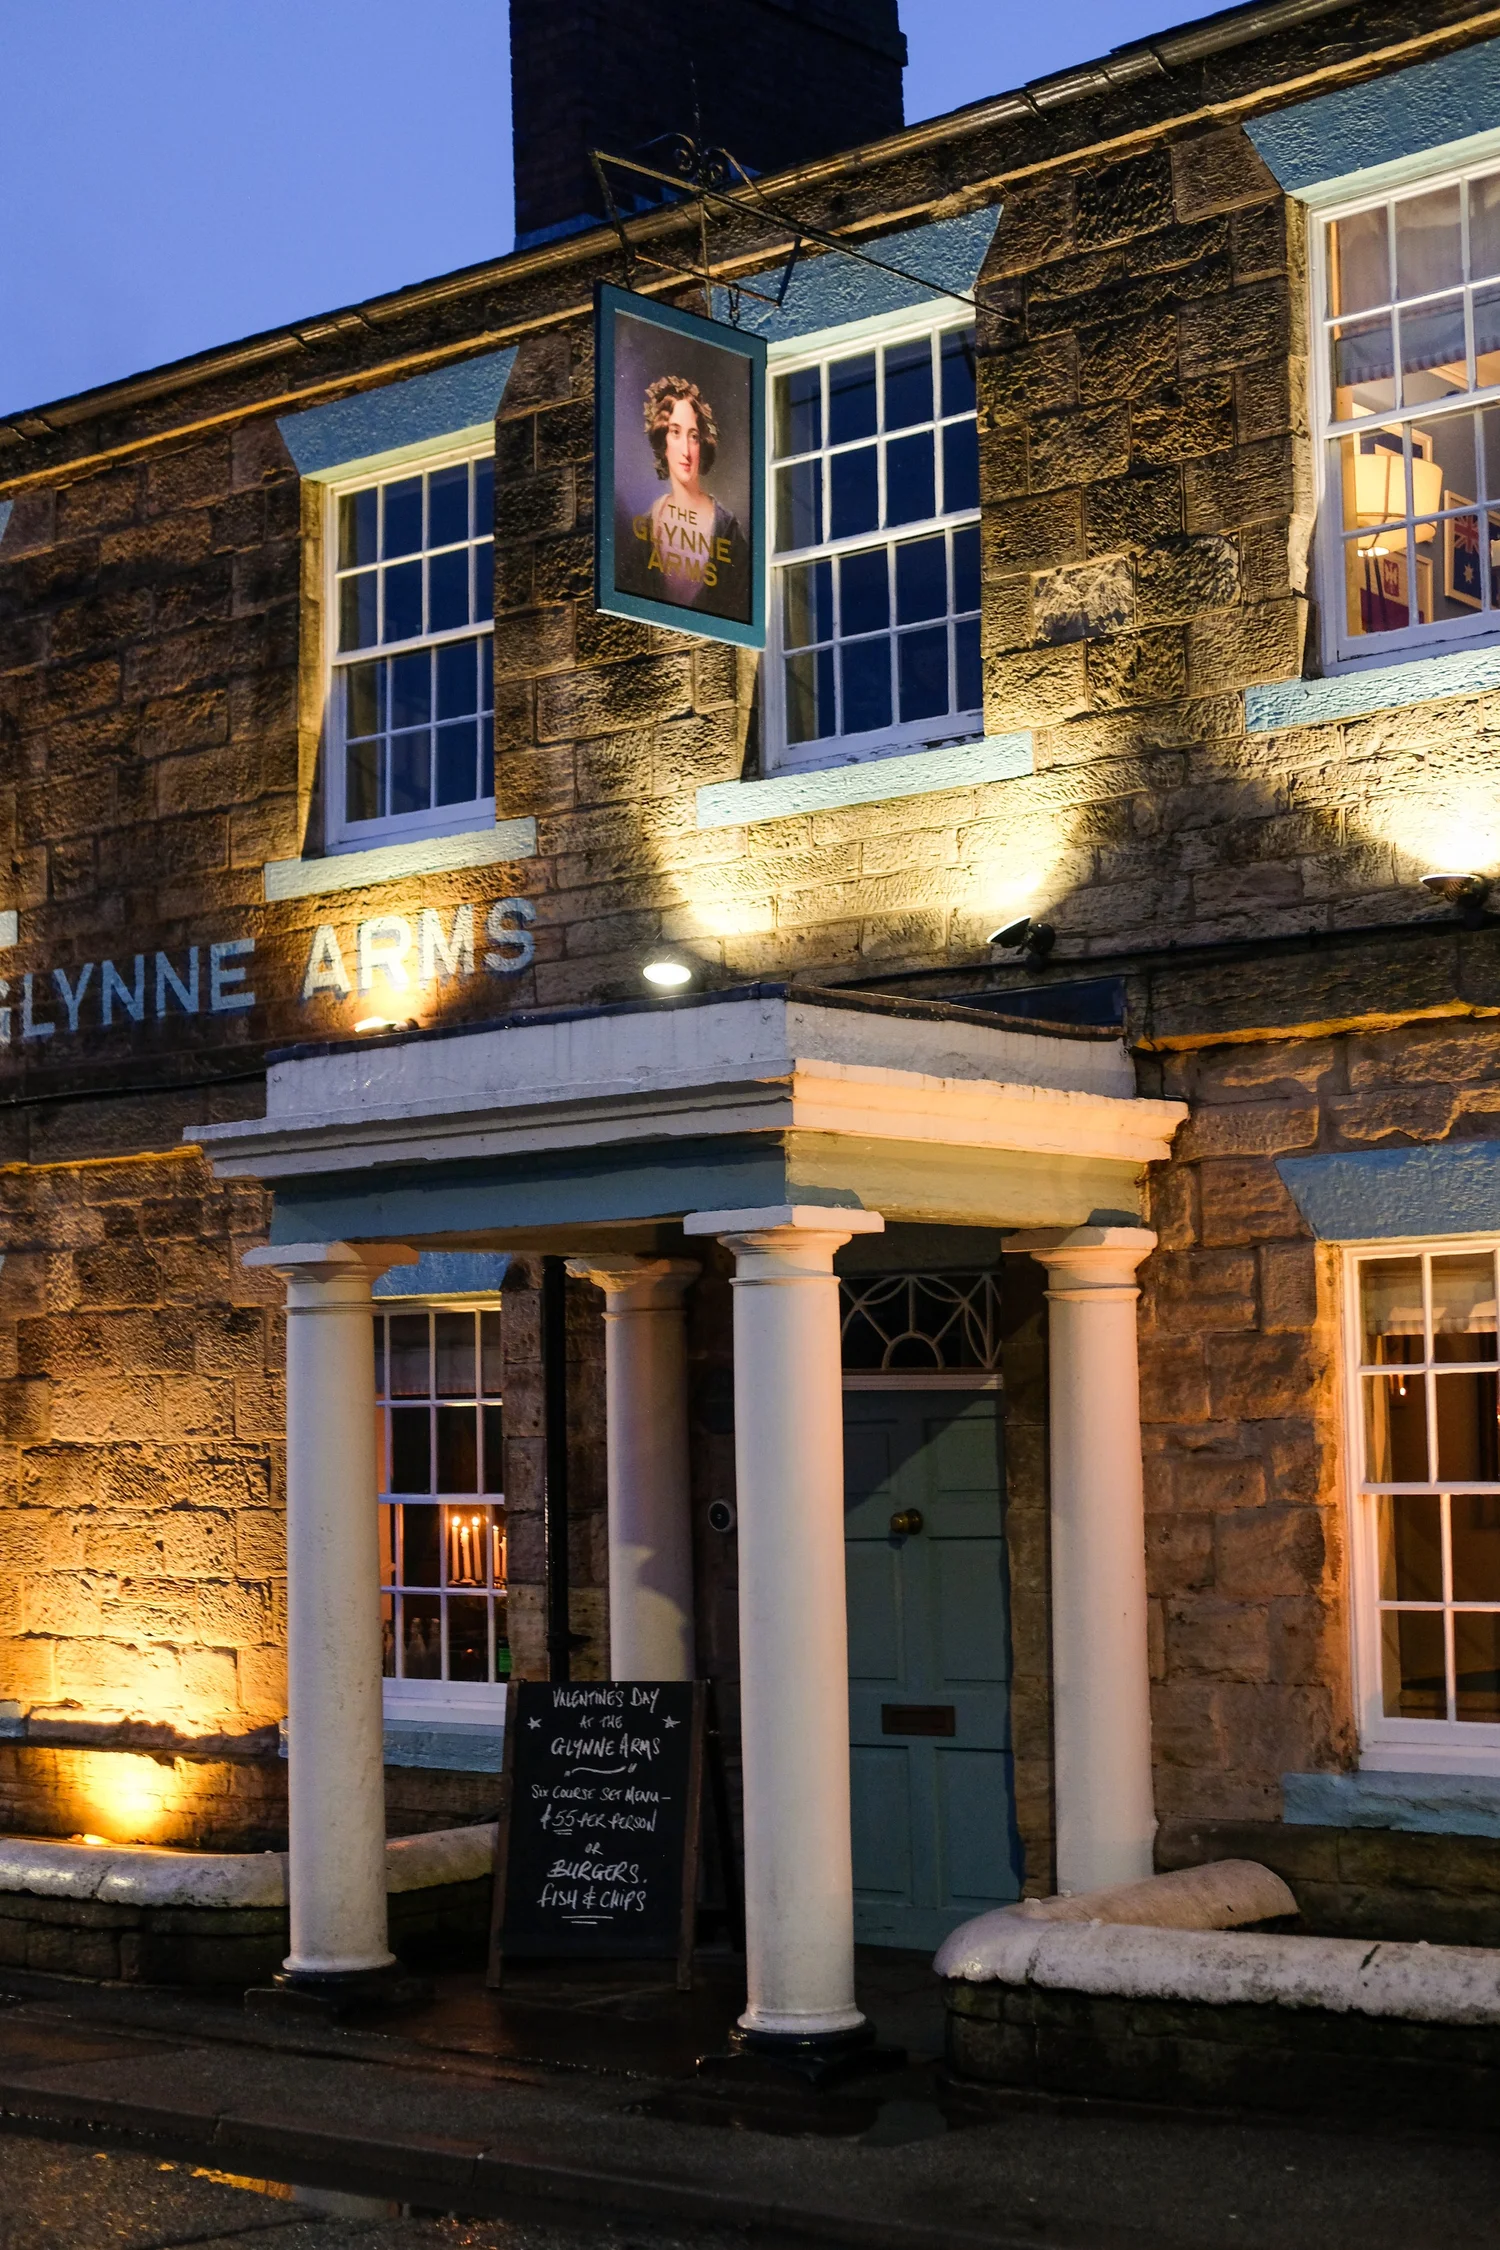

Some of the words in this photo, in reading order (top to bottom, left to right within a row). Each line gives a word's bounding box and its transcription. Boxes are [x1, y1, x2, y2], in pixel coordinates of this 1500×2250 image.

[667, 504, 698, 526] THE
[632, 515, 732, 564] GLYNNE
[647, 546, 718, 587] ARMS
[302, 896, 537, 1000] ARMS
[629, 1686, 660, 1714] DAY
[579, 1714, 595, 1729] AT
[600, 1714, 623, 1729] THE
[550, 1736, 615, 1759] GLYNNE
[619, 1732, 660, 1761] ARMS
[552, 1785, 597, 1800] COURSE
[599, 1786, 623, 1801] SET
[577, 1811, 607, 1829] PER
[608, 1808, 658, 1832] PERSON
[584, 1841, 604, 1856] OR
[581, 1885, 597, 1910] &
